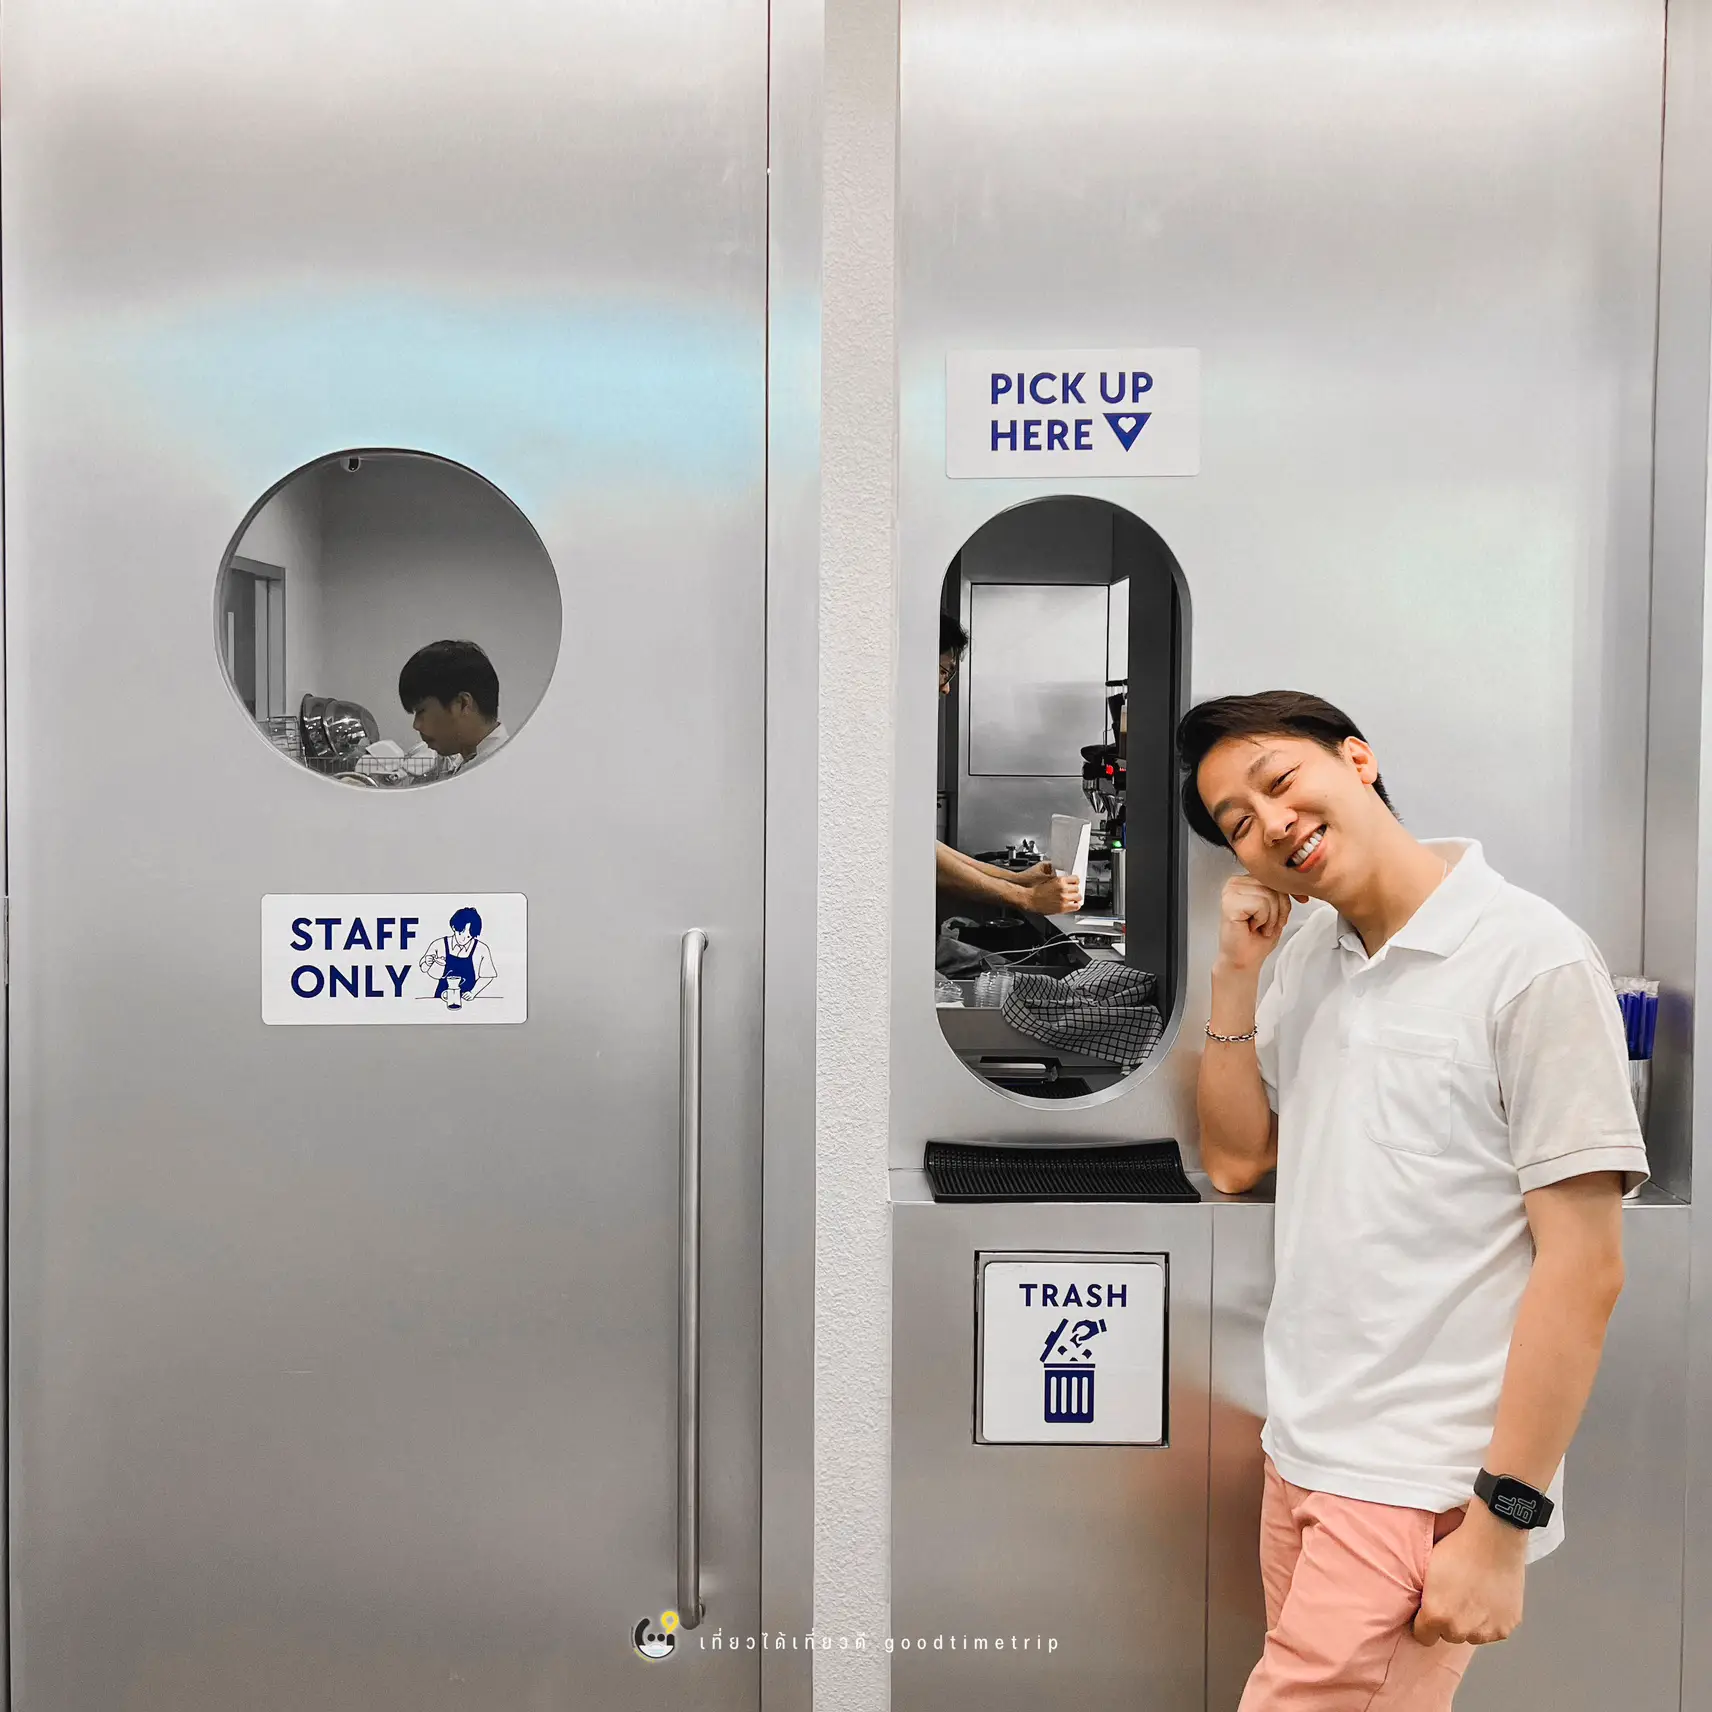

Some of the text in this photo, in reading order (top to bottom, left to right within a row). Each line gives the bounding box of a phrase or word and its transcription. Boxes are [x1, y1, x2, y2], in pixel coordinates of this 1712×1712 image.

[991, 371, 1154, 405] PICK UP
[991, 419, 1093, 451] HERE
[290, 917, 419, 951] STAFF
[290, 964, 412, 999] ONLY
[1019, 1283, 1127, 1308] TRASH
